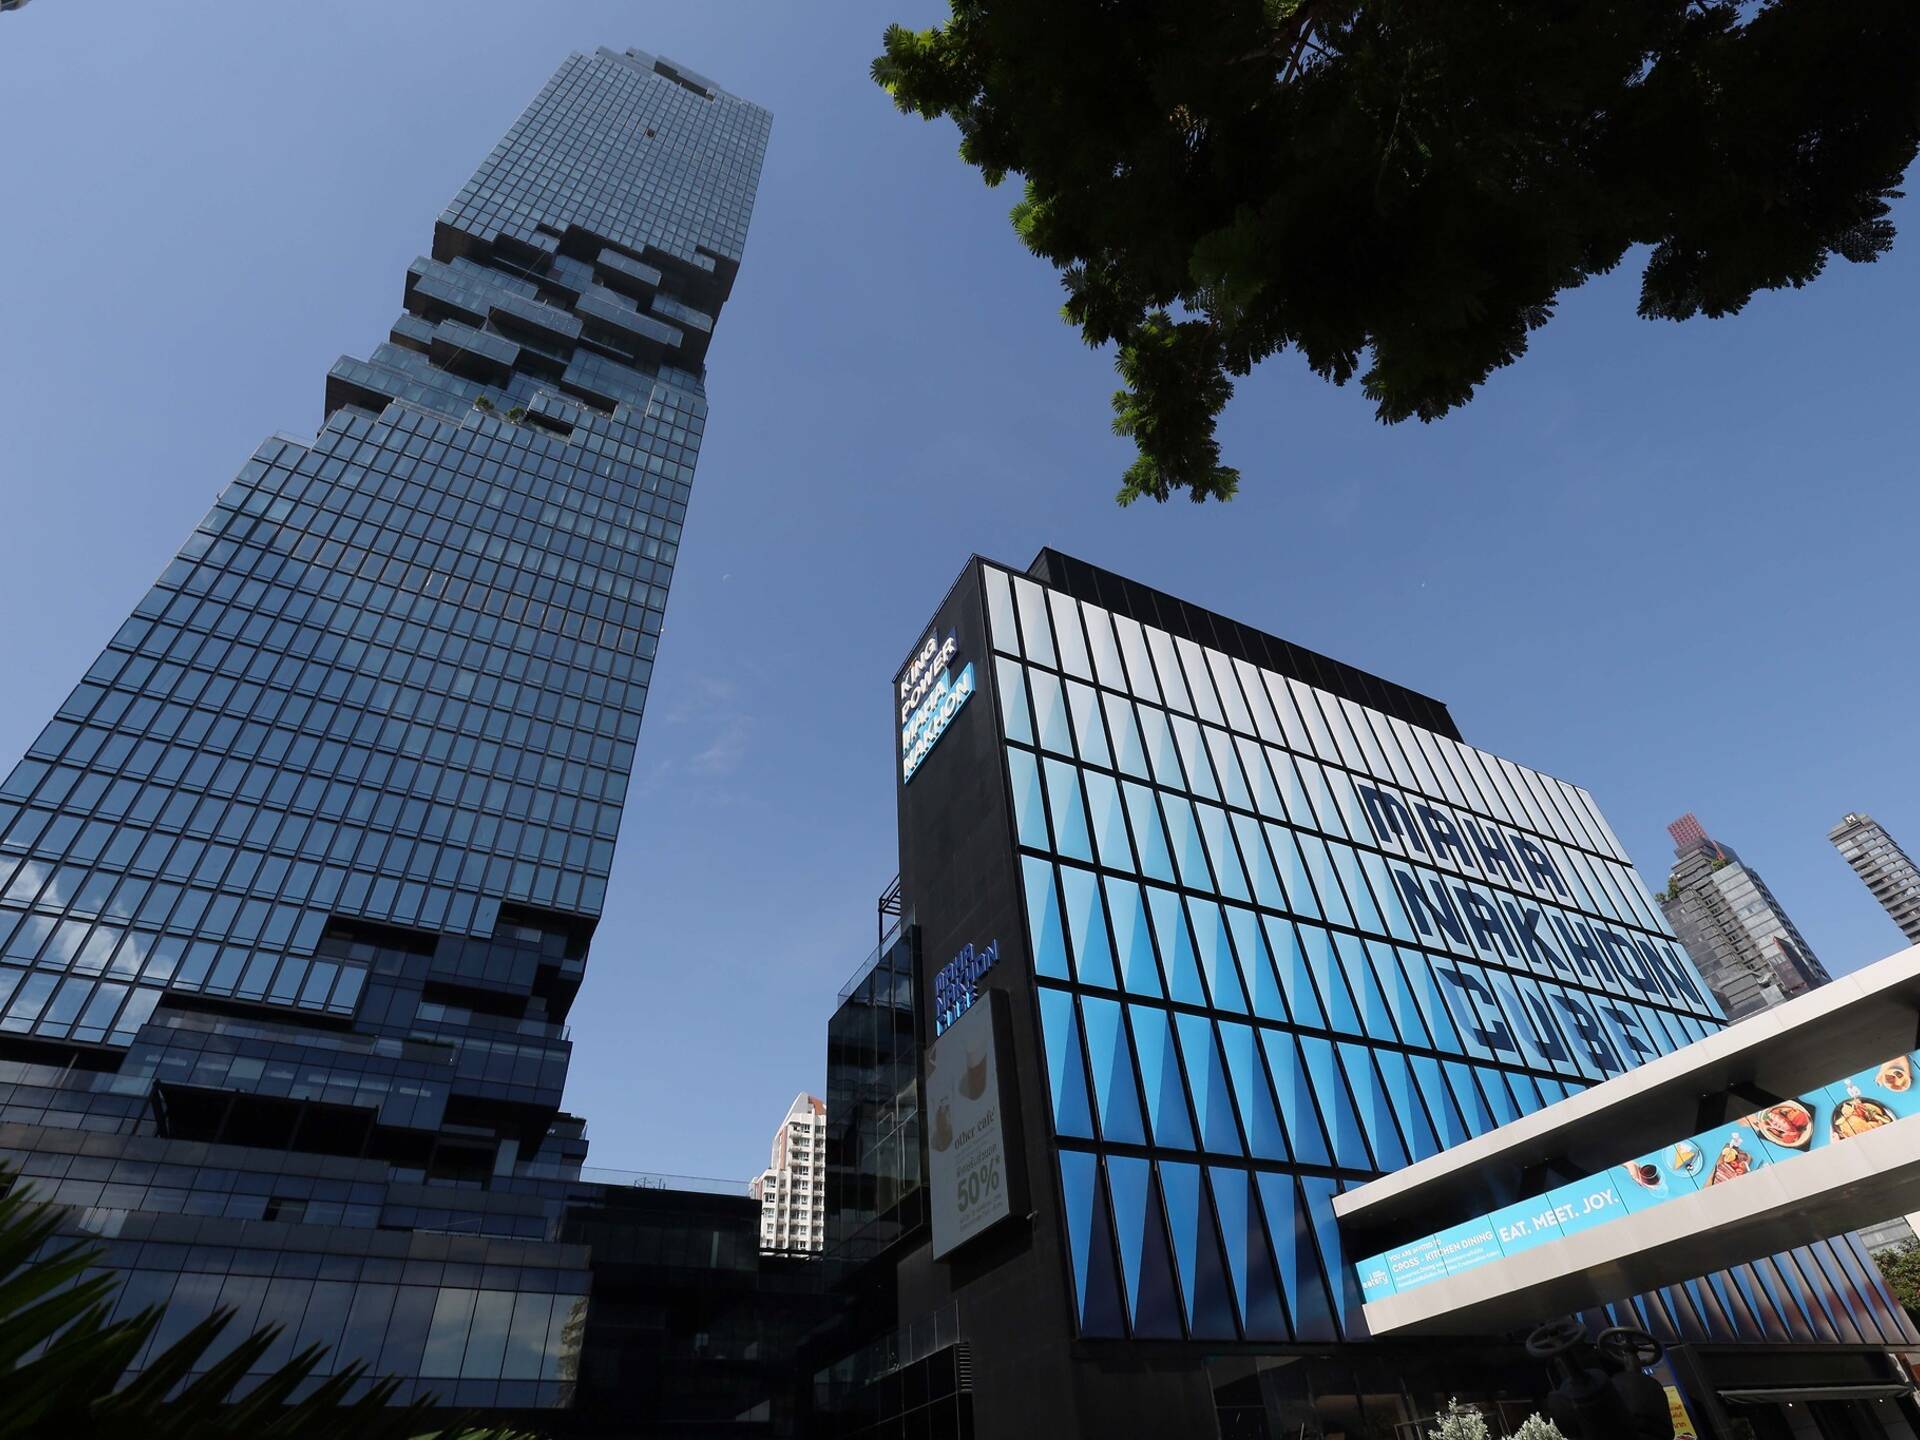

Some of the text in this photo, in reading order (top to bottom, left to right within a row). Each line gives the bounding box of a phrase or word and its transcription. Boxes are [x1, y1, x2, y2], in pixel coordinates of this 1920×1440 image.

[901, 637, 937, 699] KING
[902, 637, 955, 724] POWER
[1358, 784, 1569, 898] MAHA
[1395, 869, 1702, 1005] NAKHON
[1437, 967, 1654, 1072] CUBE
[1392, 1256, 1420, 1273] CROSS
[1462, 1231, 1494, 1249] DINING
[1499, 1189, 1619, 1242] EAT. MEET. JOY.
